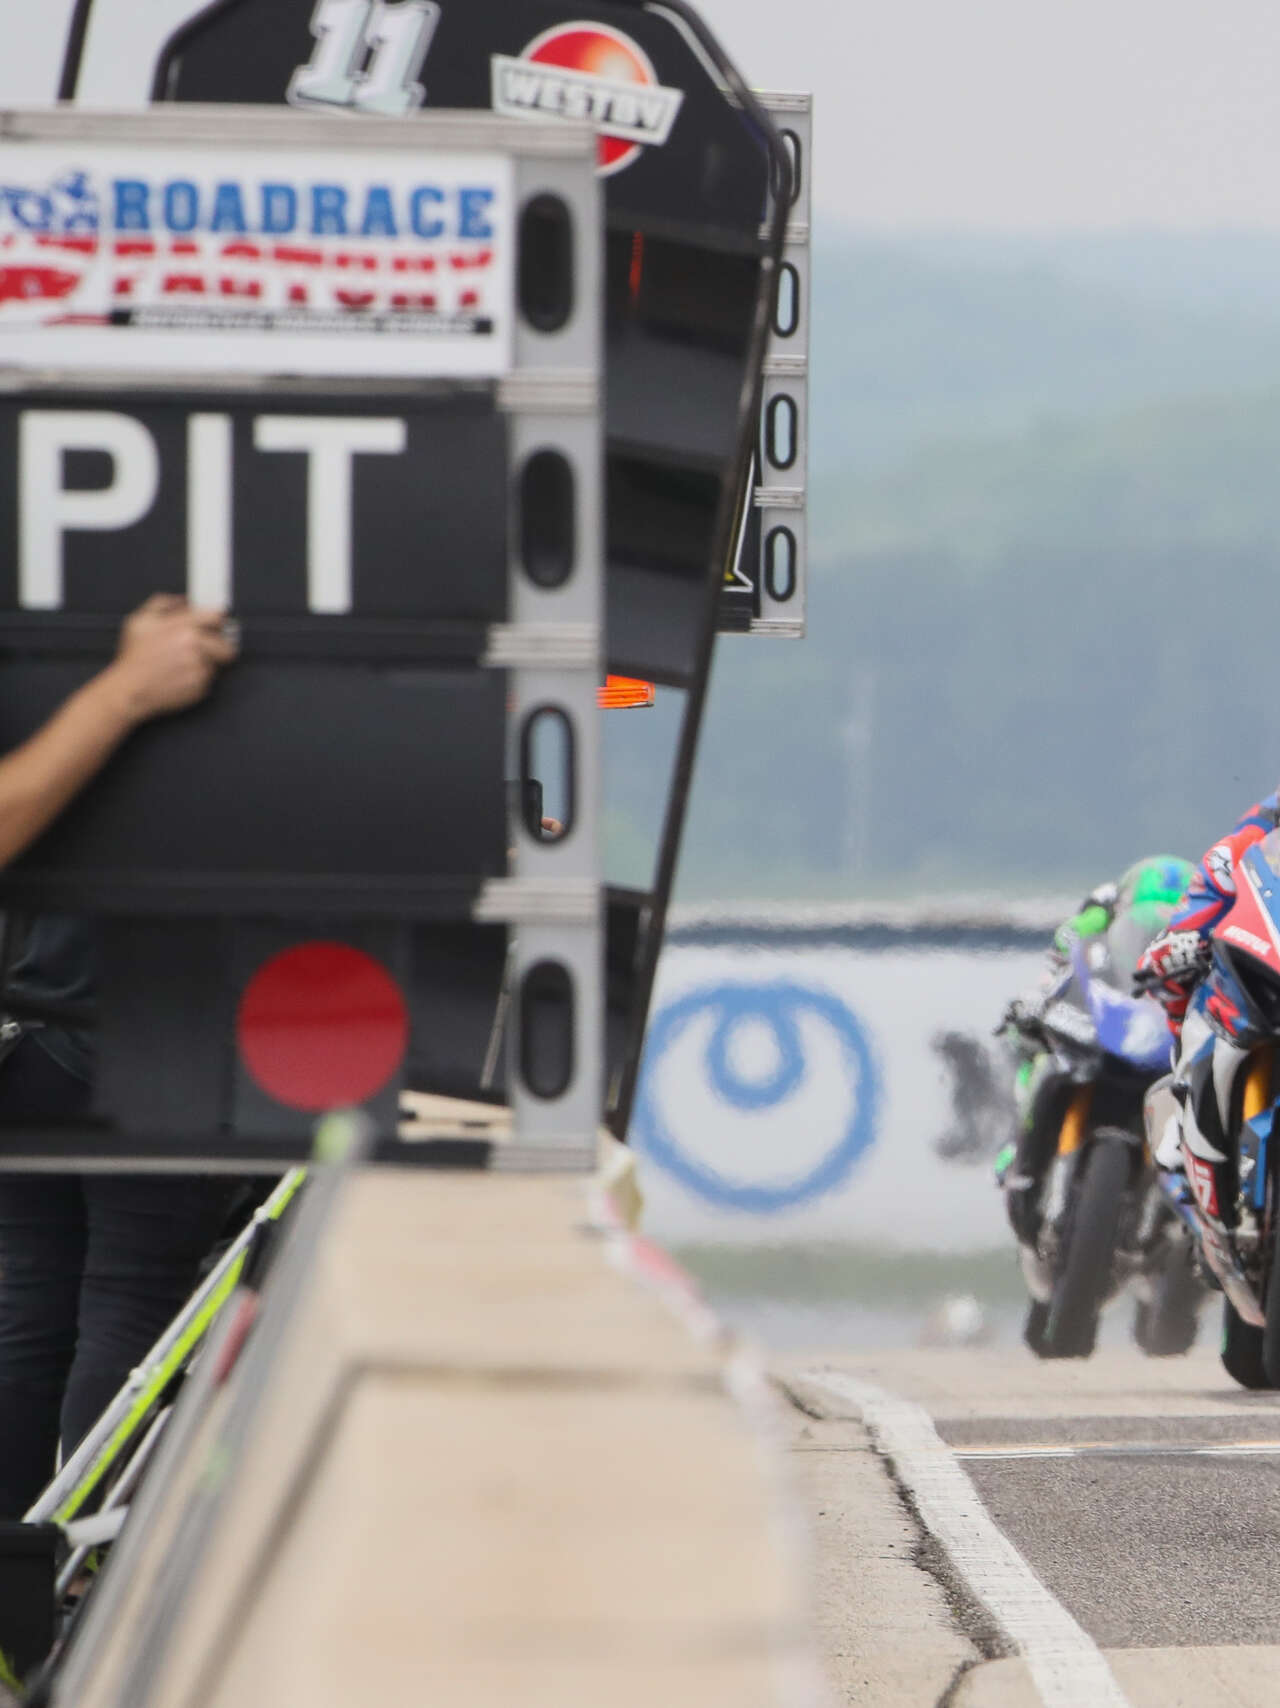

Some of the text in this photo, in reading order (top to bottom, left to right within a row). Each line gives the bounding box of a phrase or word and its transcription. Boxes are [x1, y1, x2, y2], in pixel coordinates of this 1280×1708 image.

[286, 0, 441, 116] 11
[113, 179, 494, 239] ROADRACE
[18, 409, 408, 615] PIT
